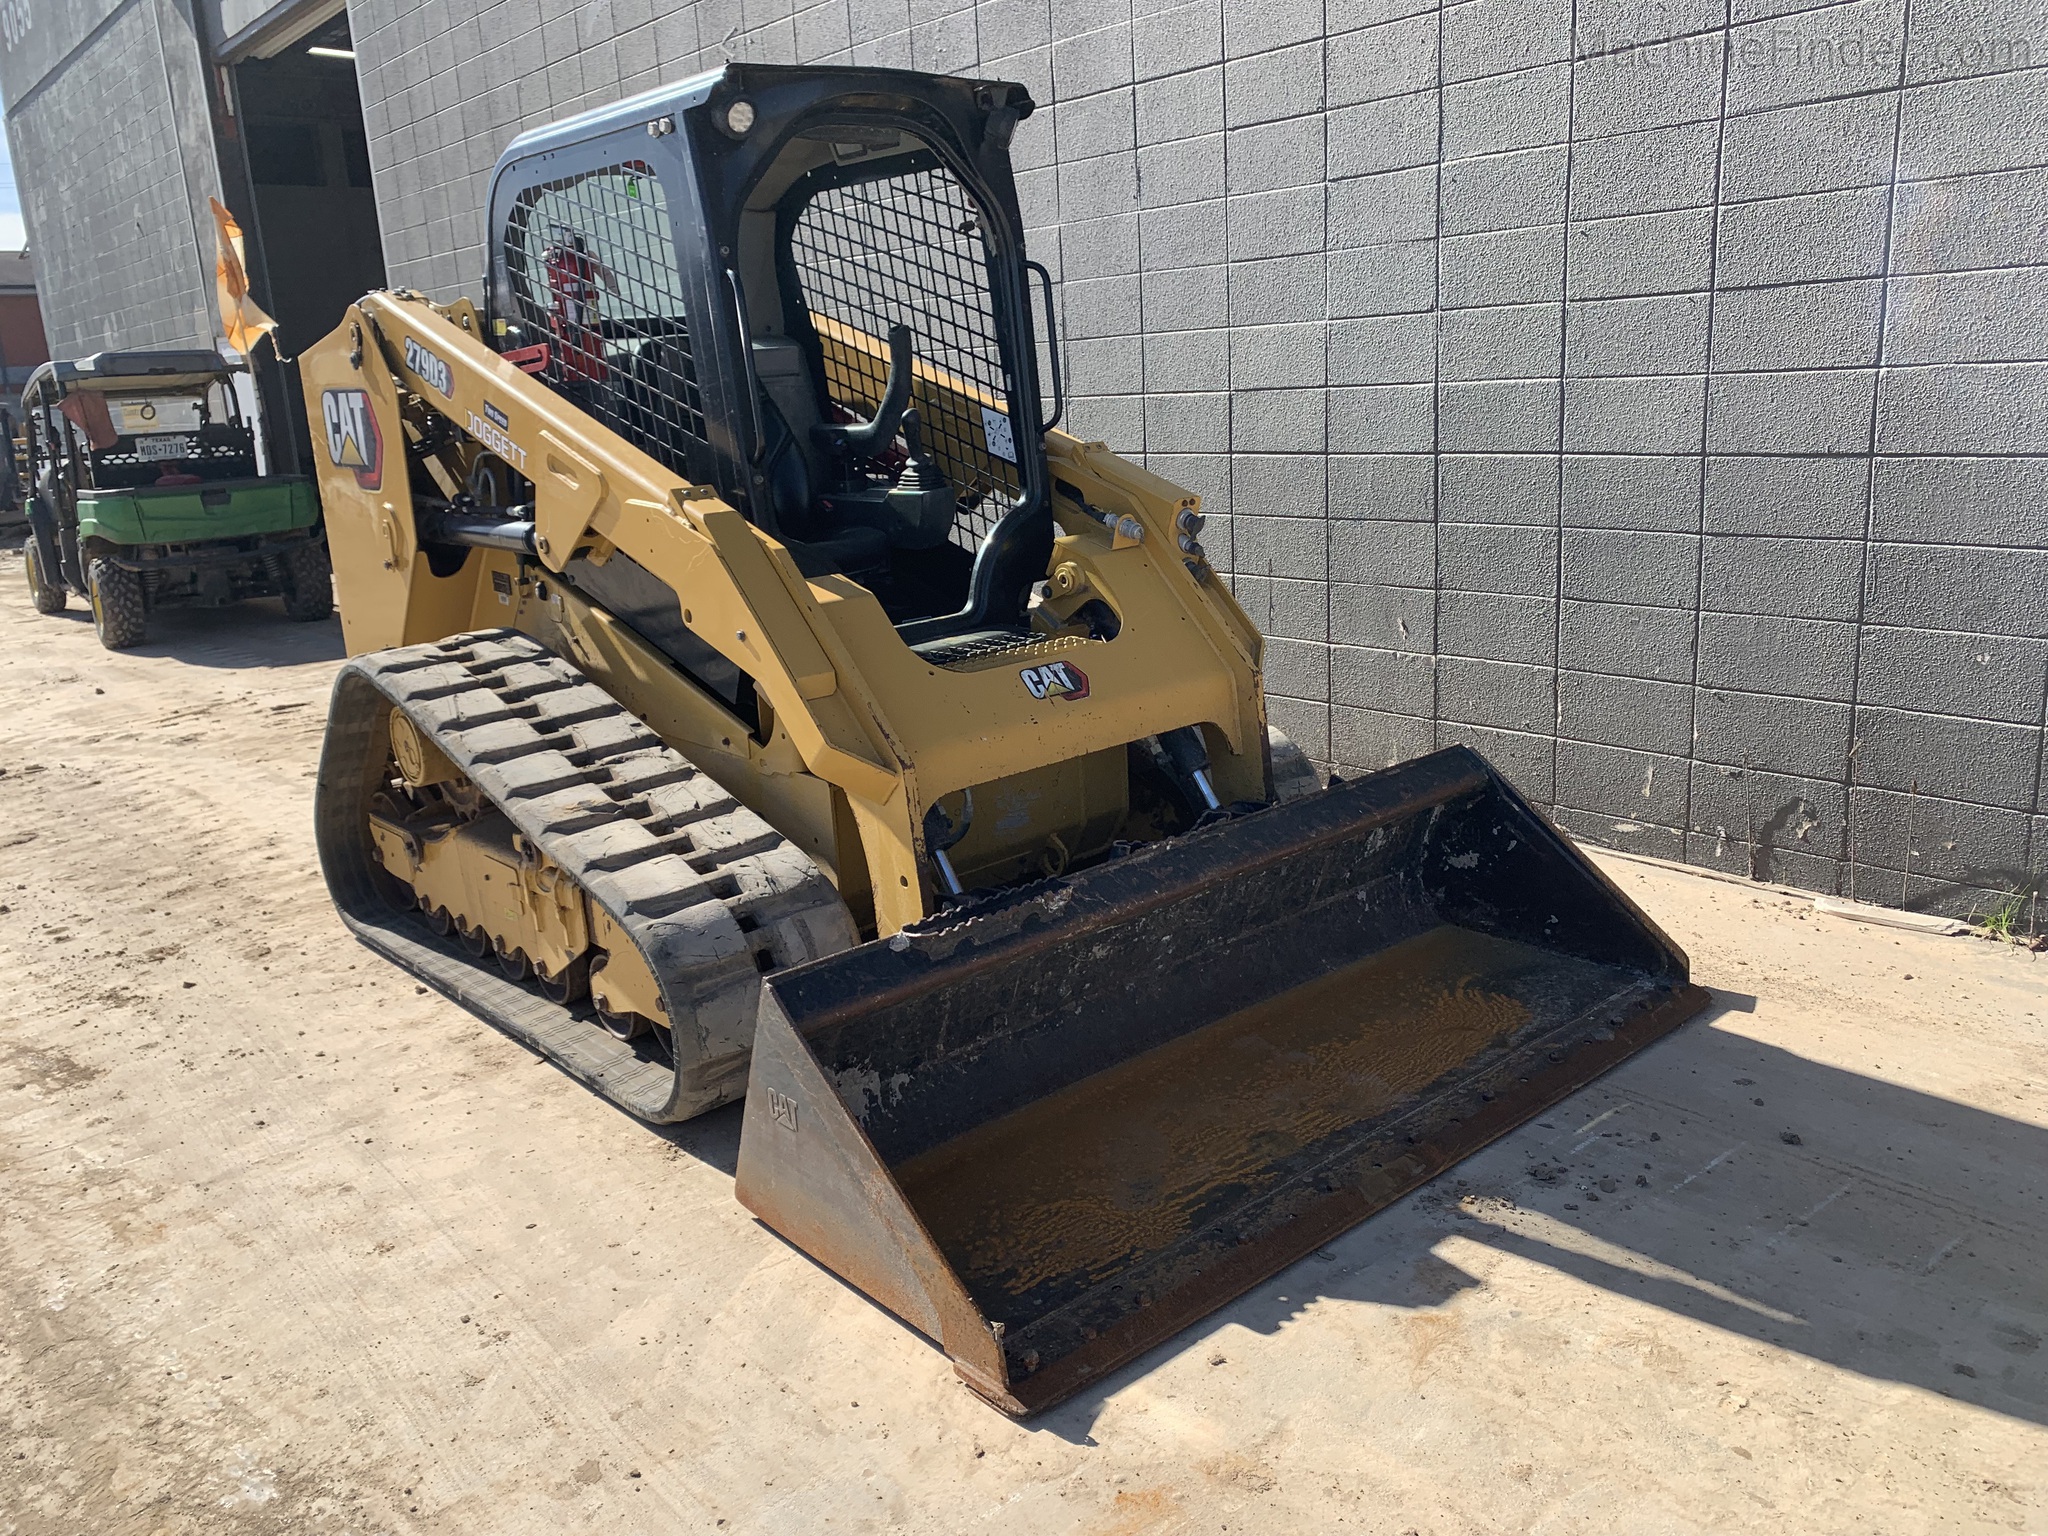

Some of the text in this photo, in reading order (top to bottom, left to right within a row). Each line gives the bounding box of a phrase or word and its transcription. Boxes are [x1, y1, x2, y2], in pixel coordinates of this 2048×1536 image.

[404, 335, 448, 393] 279D3
[322, 390, 369, 465] CAT
[1020, 662, 1075, 699] CAT
[767, 1087, 799, 1133] CAT
